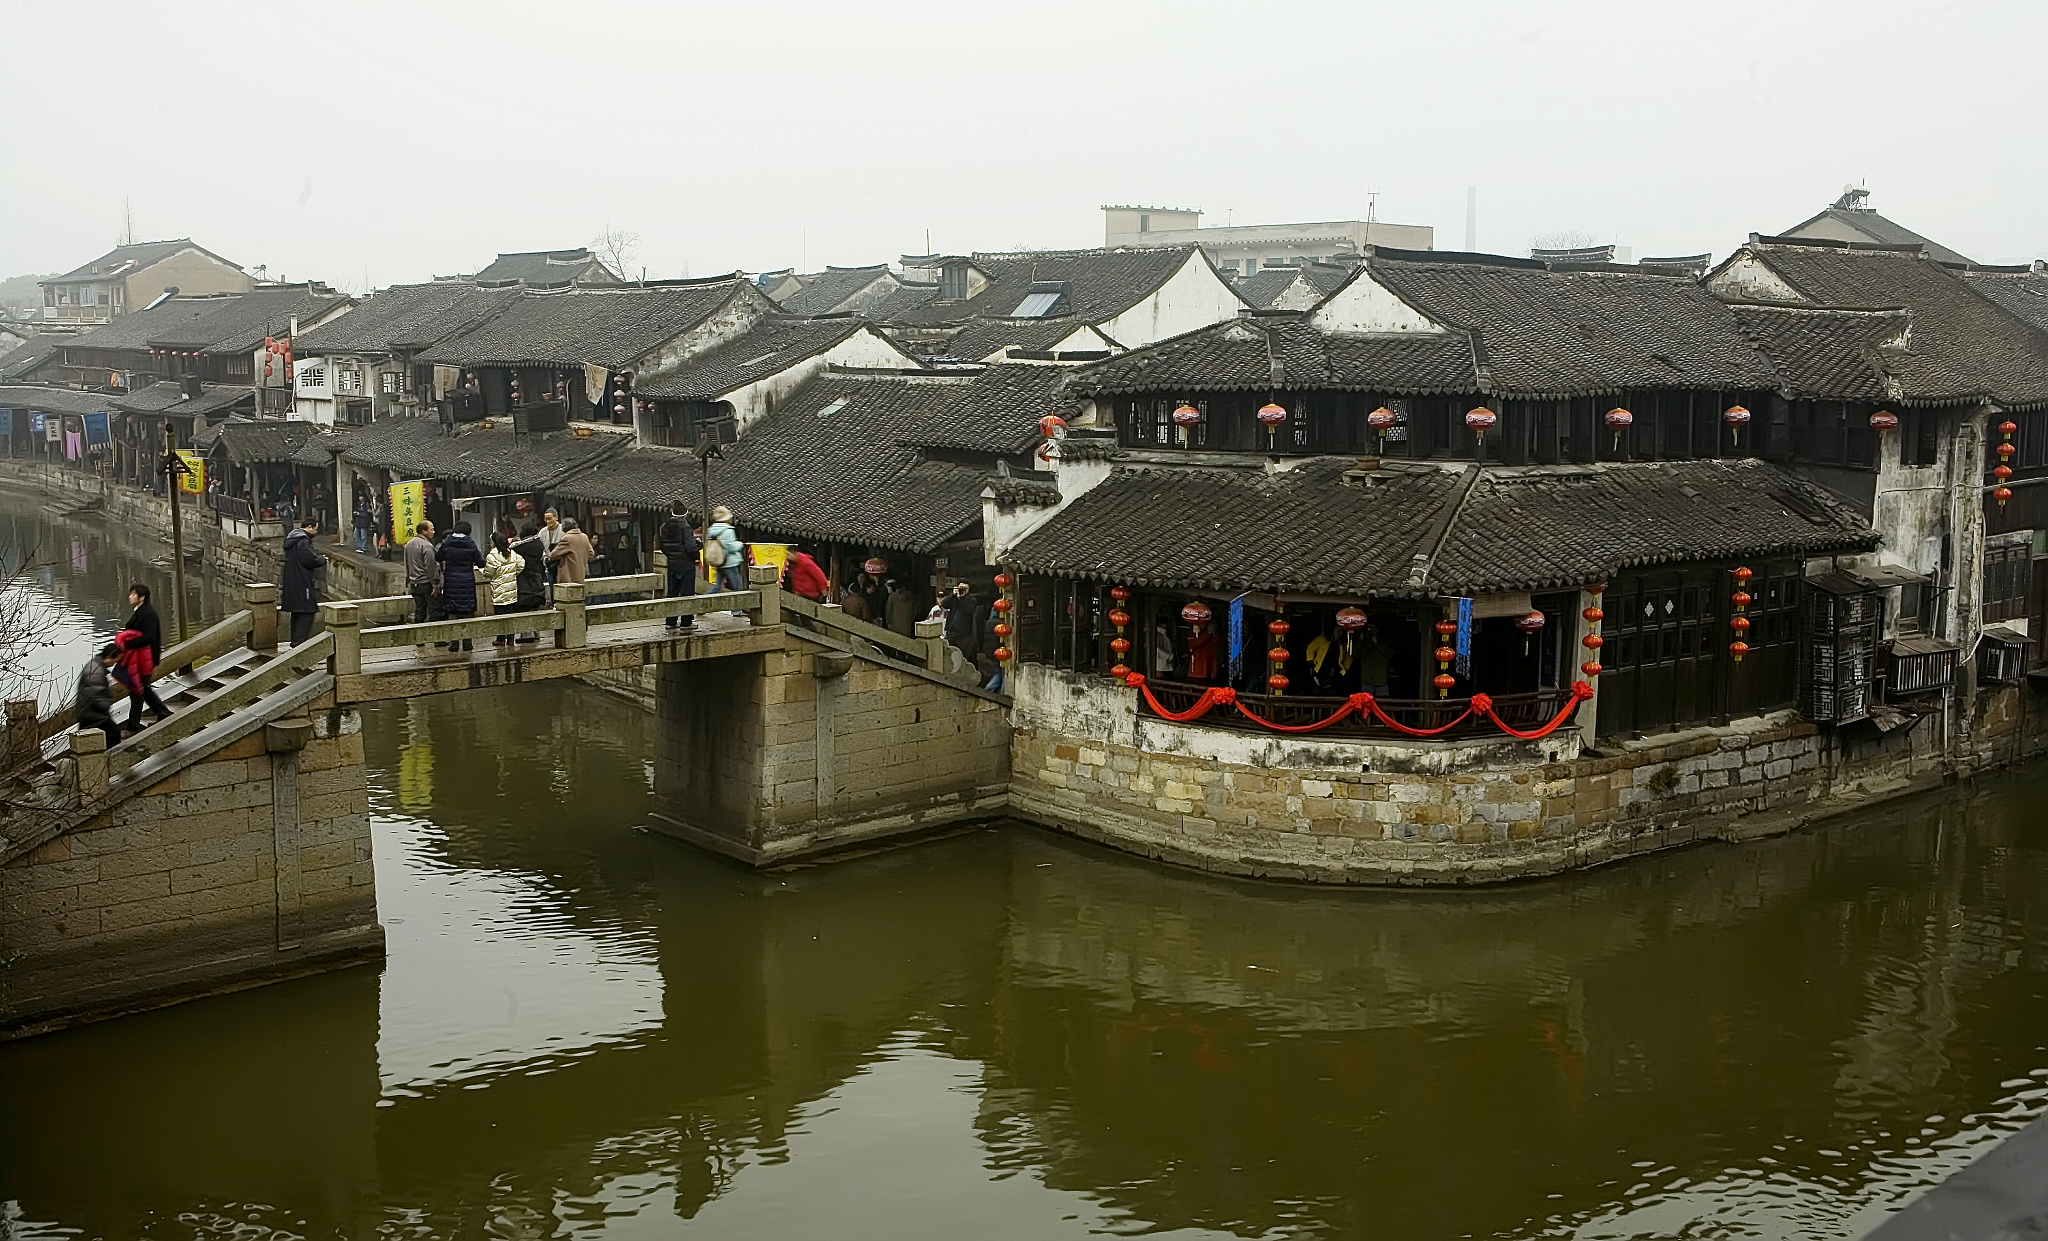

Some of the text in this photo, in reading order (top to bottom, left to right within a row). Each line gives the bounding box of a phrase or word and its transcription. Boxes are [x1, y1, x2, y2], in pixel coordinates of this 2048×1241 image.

[402, 487, 415, 538] 三味臭豆腐
